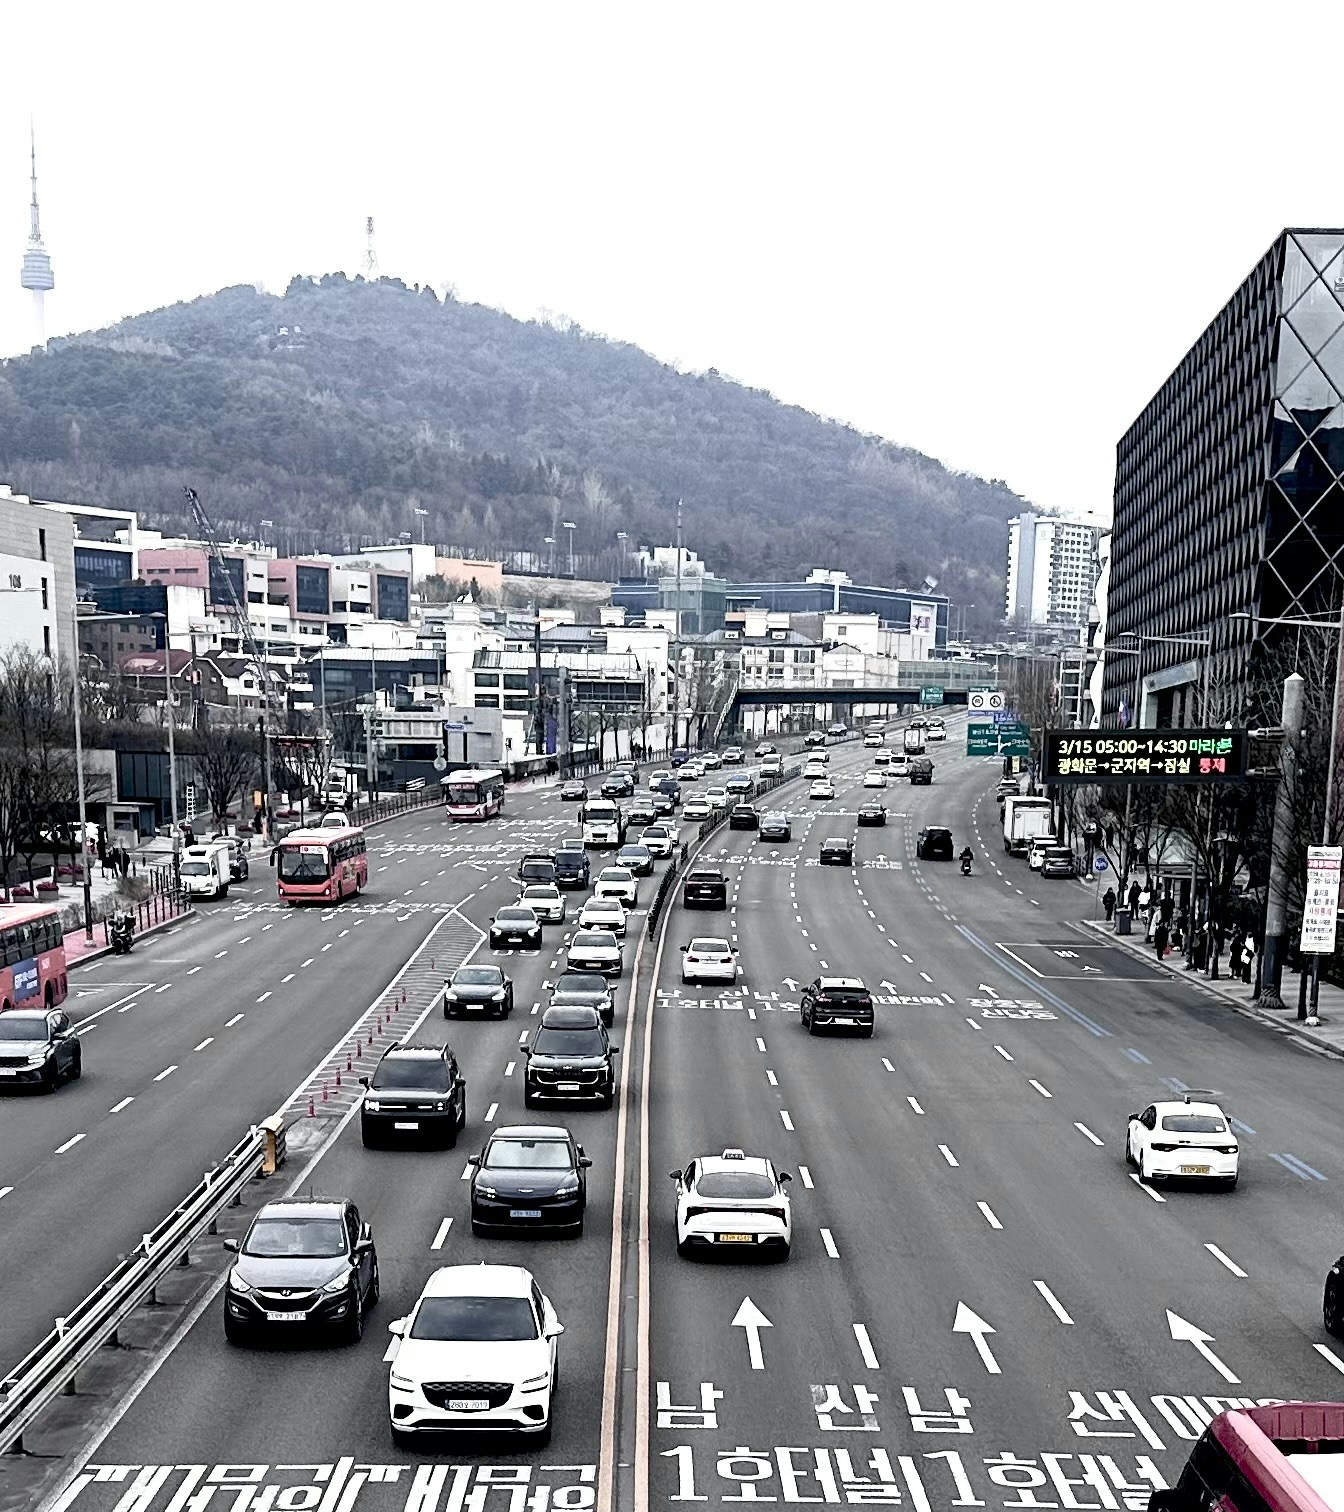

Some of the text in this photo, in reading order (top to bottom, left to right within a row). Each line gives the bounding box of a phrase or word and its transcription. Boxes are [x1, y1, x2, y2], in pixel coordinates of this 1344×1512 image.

[1058, 739, 1093, 755] 3/15
[1095, 739, 1188, 754] 05:00~14:30
[1058, 757, 1098, 775] 광화문
[1163, 757, 1191, 774] 잠실
[1198, 757, 1226, 774] 통제
[659, 1445, 903, 1505] 1호터널
